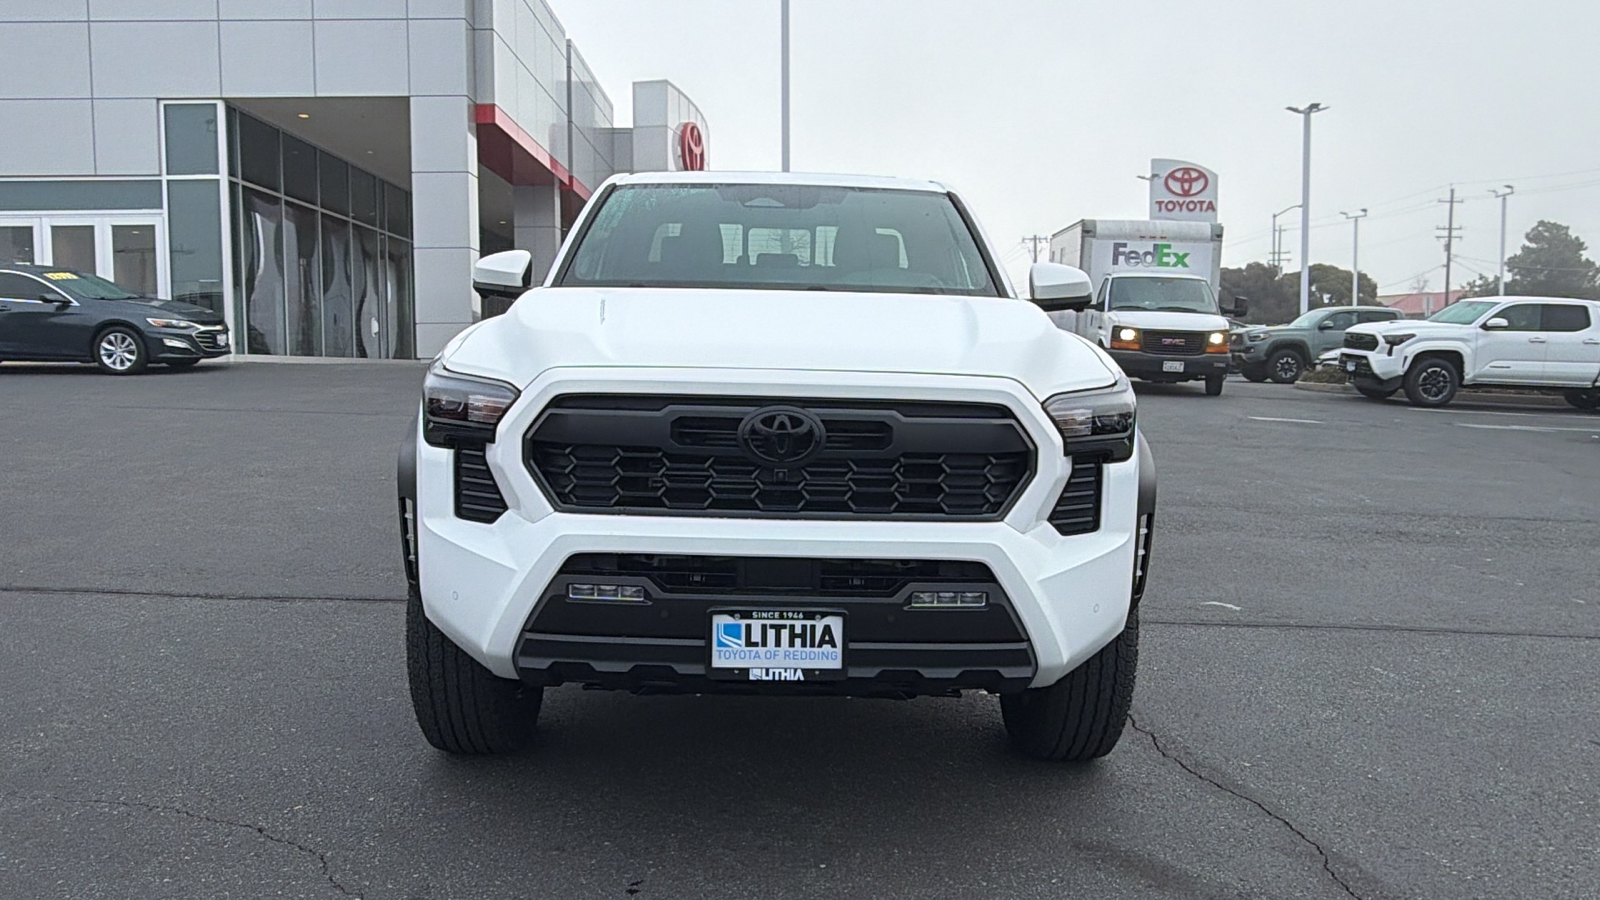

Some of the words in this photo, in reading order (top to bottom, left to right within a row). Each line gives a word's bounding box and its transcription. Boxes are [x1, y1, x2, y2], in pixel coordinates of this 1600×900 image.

[1155, 200, 1216, 212] TOYOTA
[1112, 242, 1190, 268] FedEx
[752, 611, 780, 619] SINCE
[744, 623, 838, 648] LITHIA
[717, 649, 761, 660] TOYOTA
[764, 650, 780, 660] OF
[783, 650, 838, 661] REDDING
[762, 668, 805, 681] LITHIA
